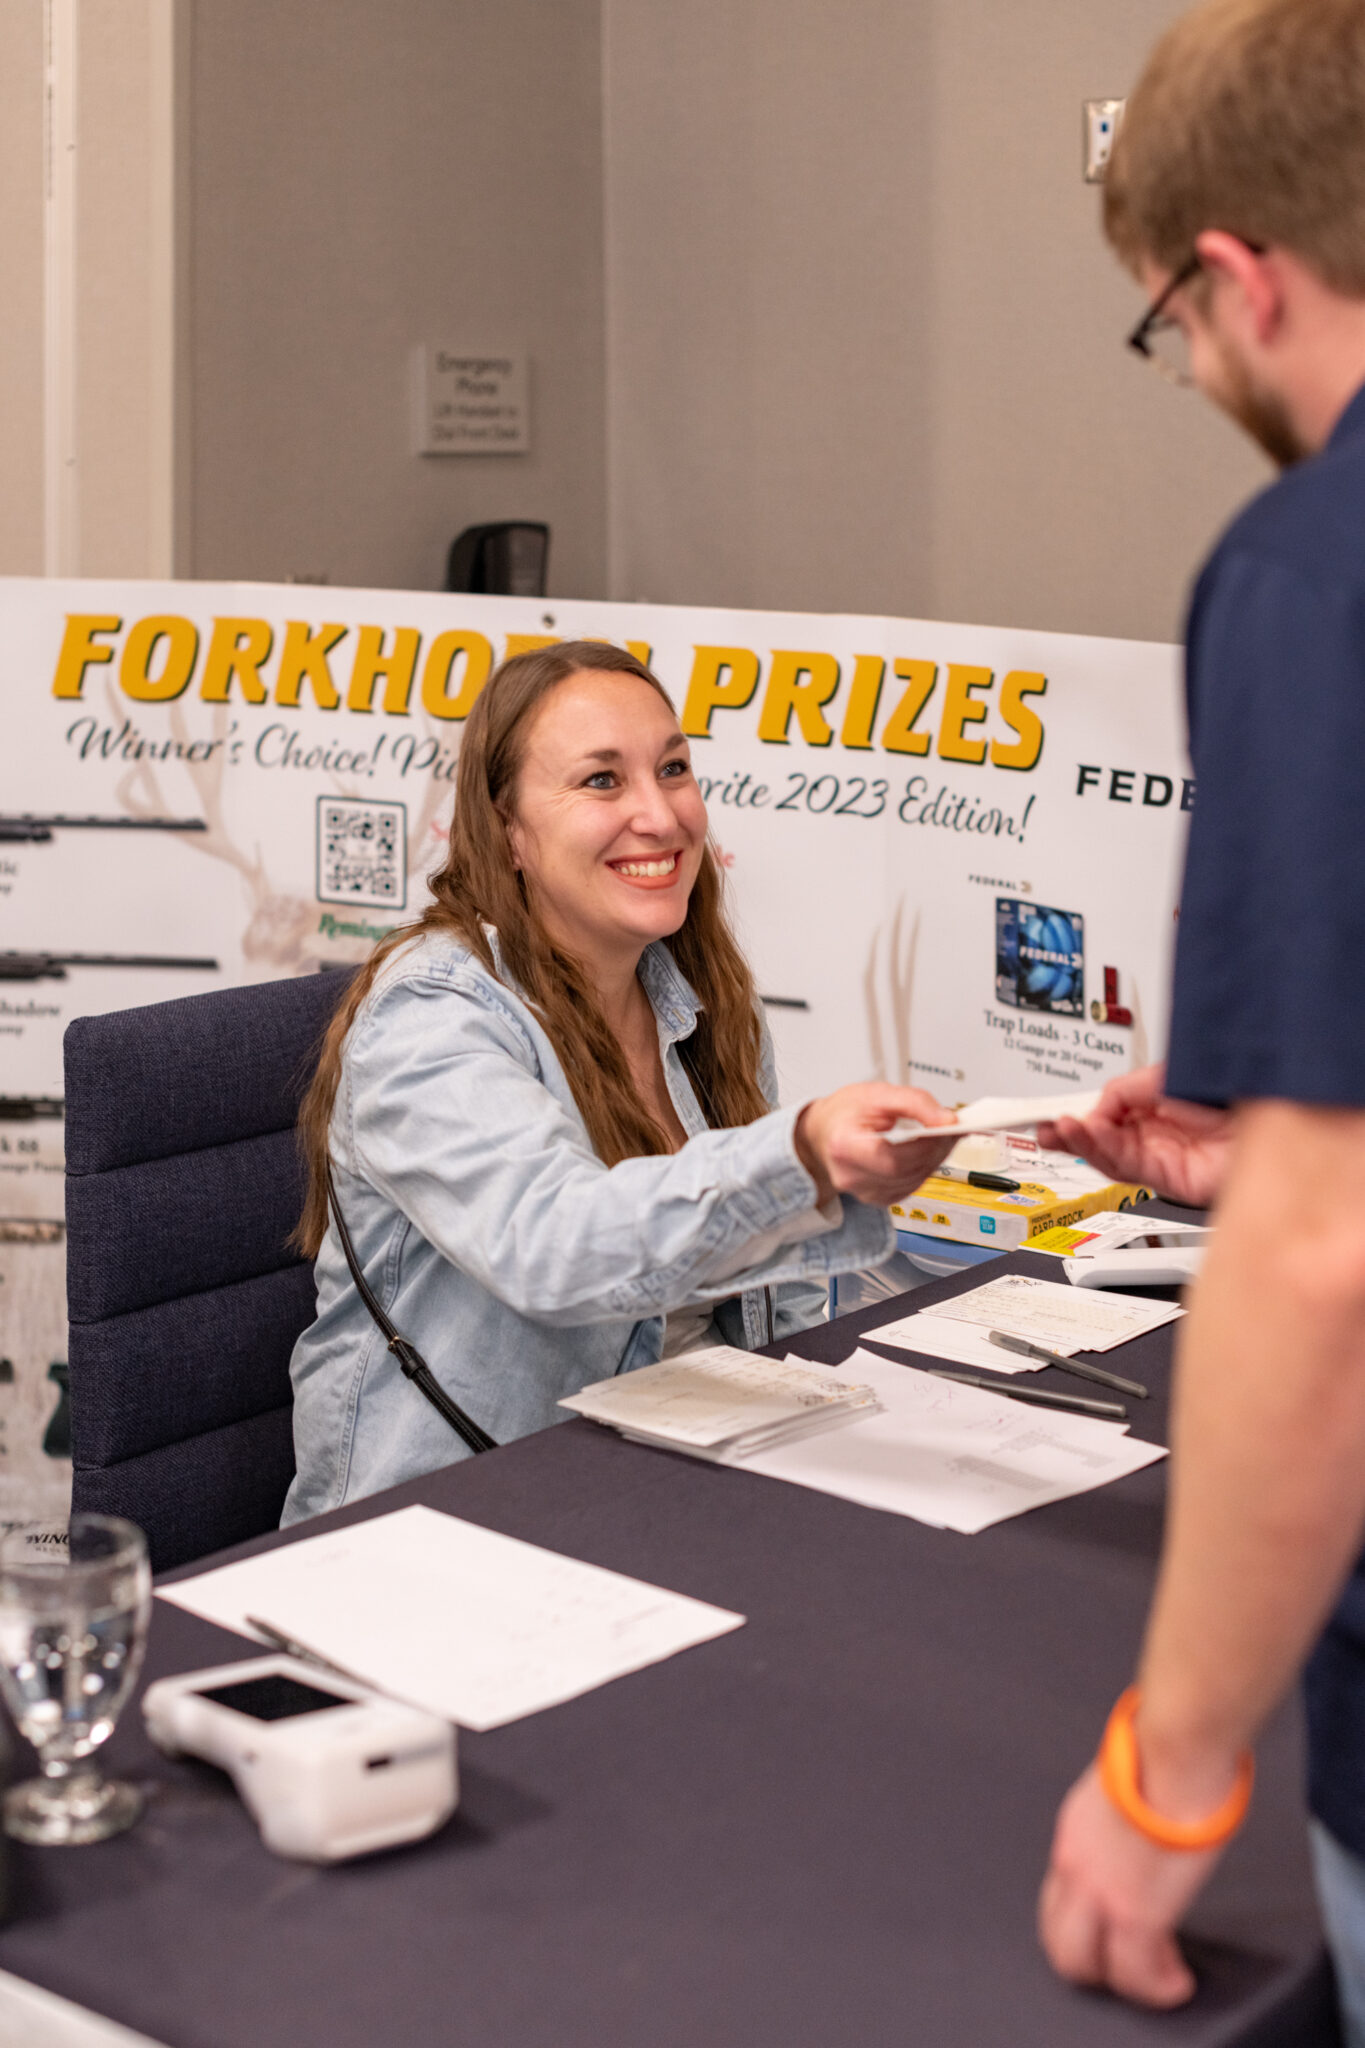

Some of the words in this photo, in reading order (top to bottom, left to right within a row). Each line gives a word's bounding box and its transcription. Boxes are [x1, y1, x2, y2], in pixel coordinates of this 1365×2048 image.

[51, 613, 653, 721] FORKHO
[680, 645, 1048, 771] PRIZES
[66, 716, 245, 766] Winner's
[255, 723, 387, 777] Choice!
[391, 733, 459, 781] Pic
[775, 772, 889, 819] 2023
[899, 776, 1036, 843] Edition!
[1076, 763, 1196, 812] FEDE
[968, 873, 1017, 891] FEDERAL
[1019, 945, 1071, 966] FEDERAL
[0, 998, 60, 1018] hadow
[984, 1008, 1015, 1035] Trap
[1019, 1017, 1060, 1041] Loads
[1072, 1029, 1081, 1046] 3
[1084, 1032, 1125, 1056] Cases
